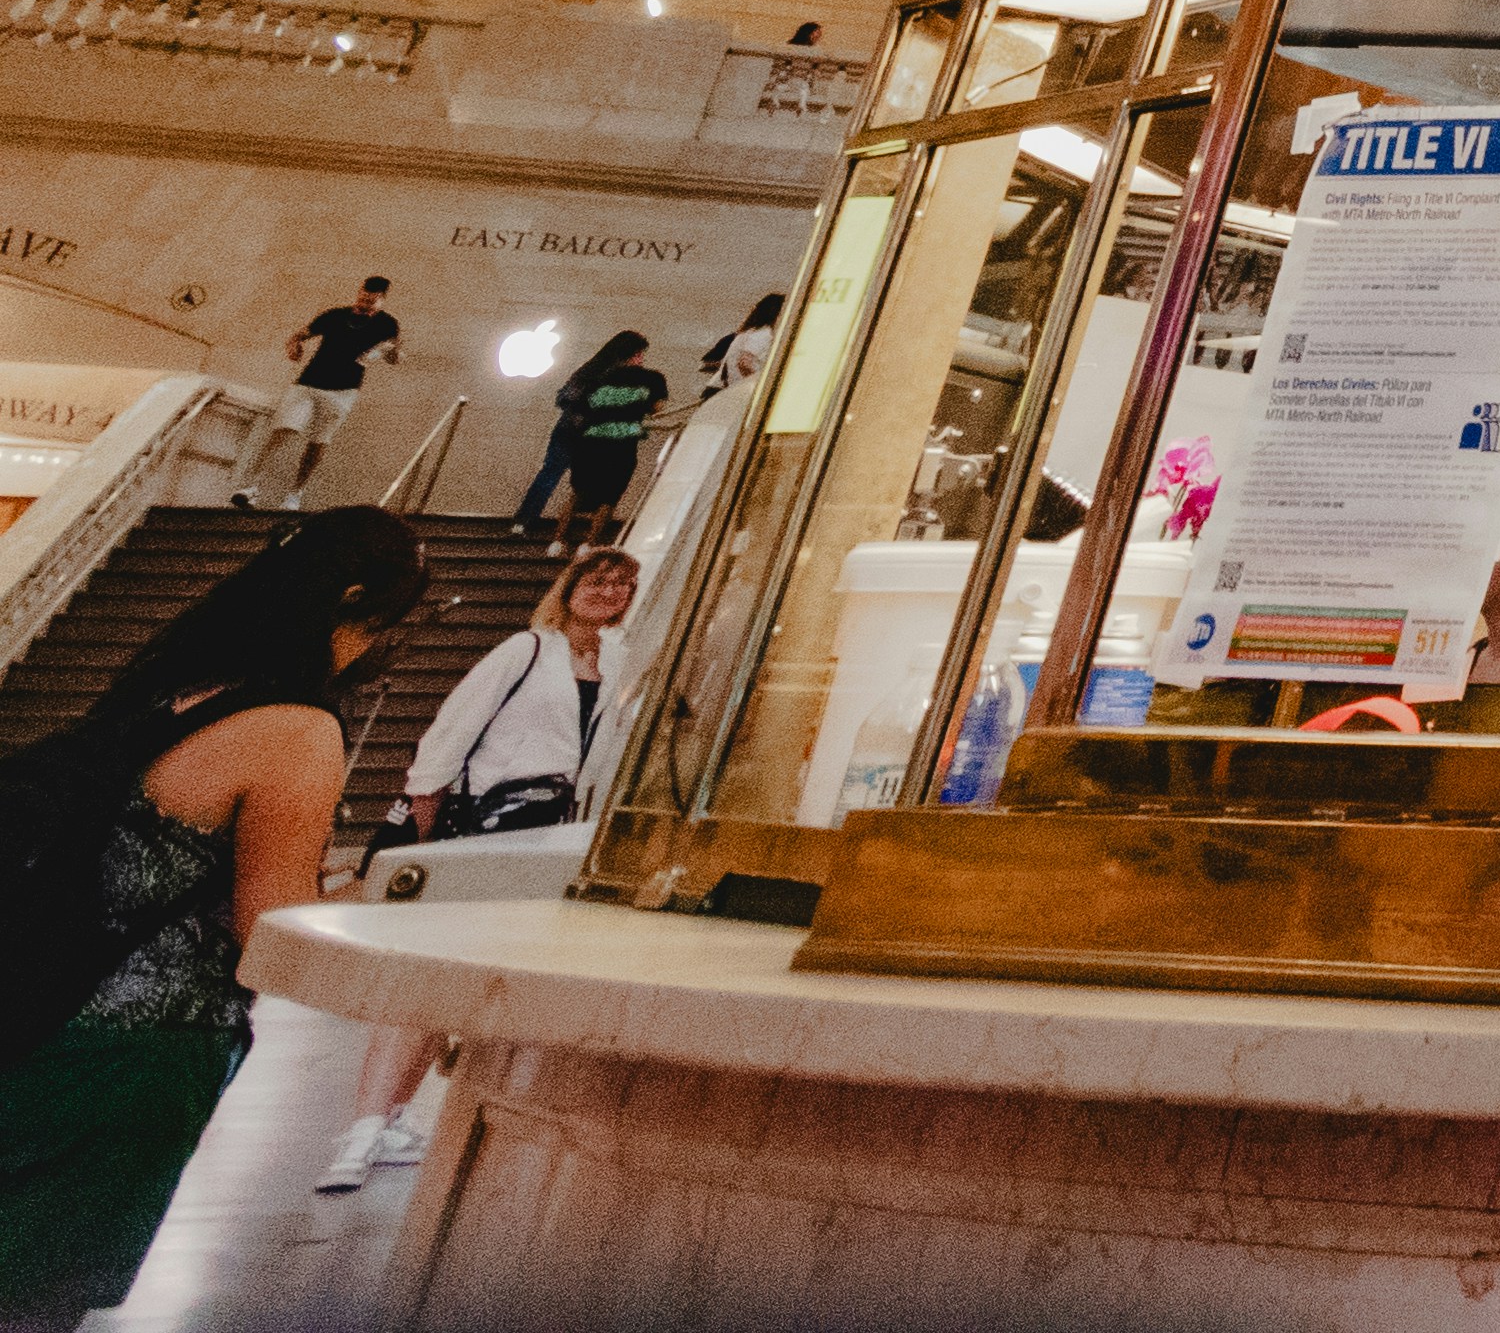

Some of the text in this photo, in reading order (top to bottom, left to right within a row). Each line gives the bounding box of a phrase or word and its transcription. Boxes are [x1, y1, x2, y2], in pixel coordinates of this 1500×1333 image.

[1340, 125, 1492, 171] TITLE VI
[1325, 192, 1348, 206] Civil
[1350, 192, 1386, 207] Rights:
[1456, 192, 1500, 207] Complaint
[1343, 209, 1462, 222] MTA Metro-North Railroad
[449, 226, 697, 263] EAST BALCONY
[1272, 377, 1290, 390] Los
[1292, 377, 1338, 391] Derechos
[1341, 377, 1380, 391] Civiles:
[1265, 409, 1383, 423] MTA Metro-North Railroad
[1414, 627, 1451, 656] 511
